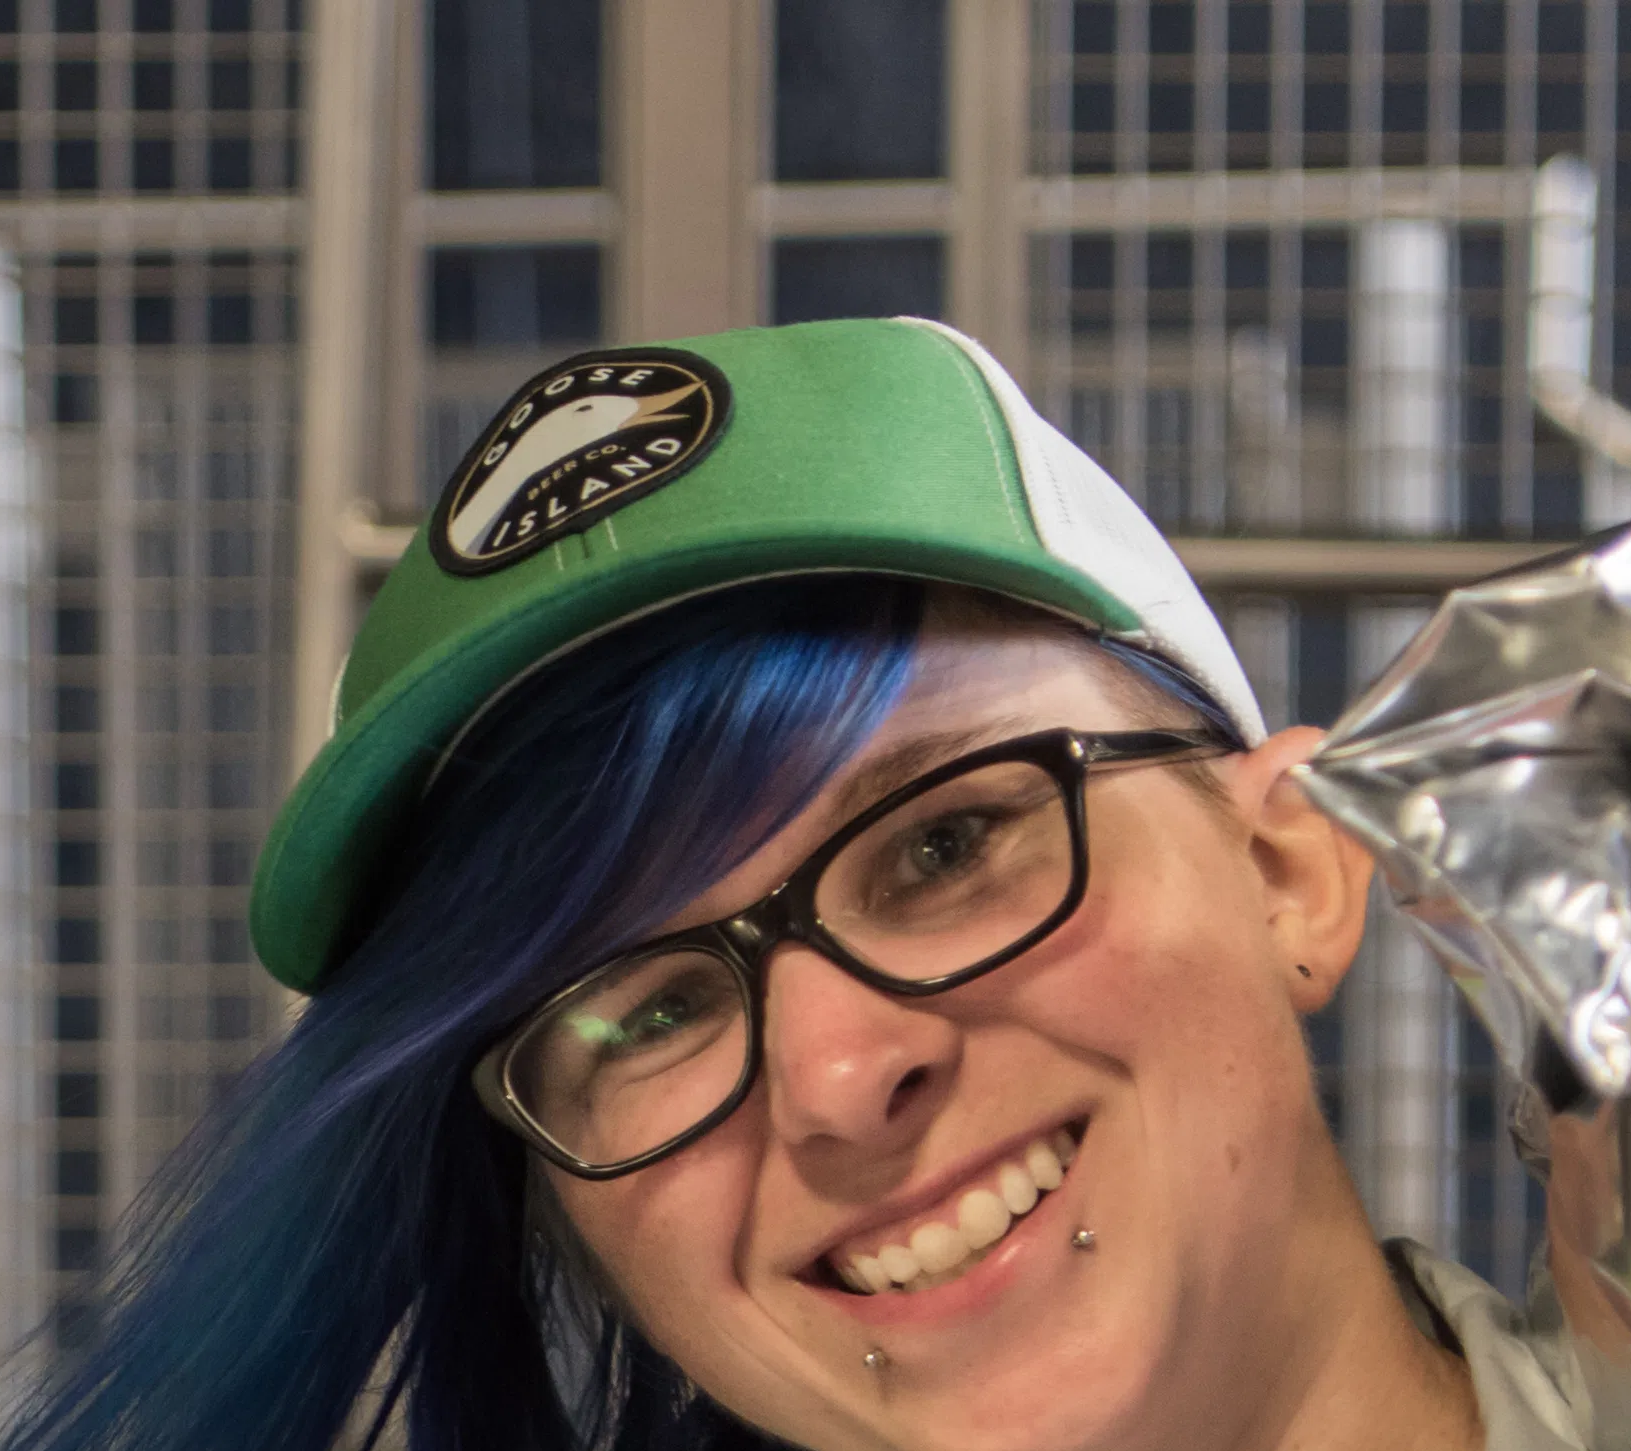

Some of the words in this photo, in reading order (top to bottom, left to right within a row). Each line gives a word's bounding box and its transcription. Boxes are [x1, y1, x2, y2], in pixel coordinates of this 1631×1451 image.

[484, 367, 654, 466] GOOSE
[492, 437, 682, 548] ISLAND
[527, 459, 578, 502] BEER
